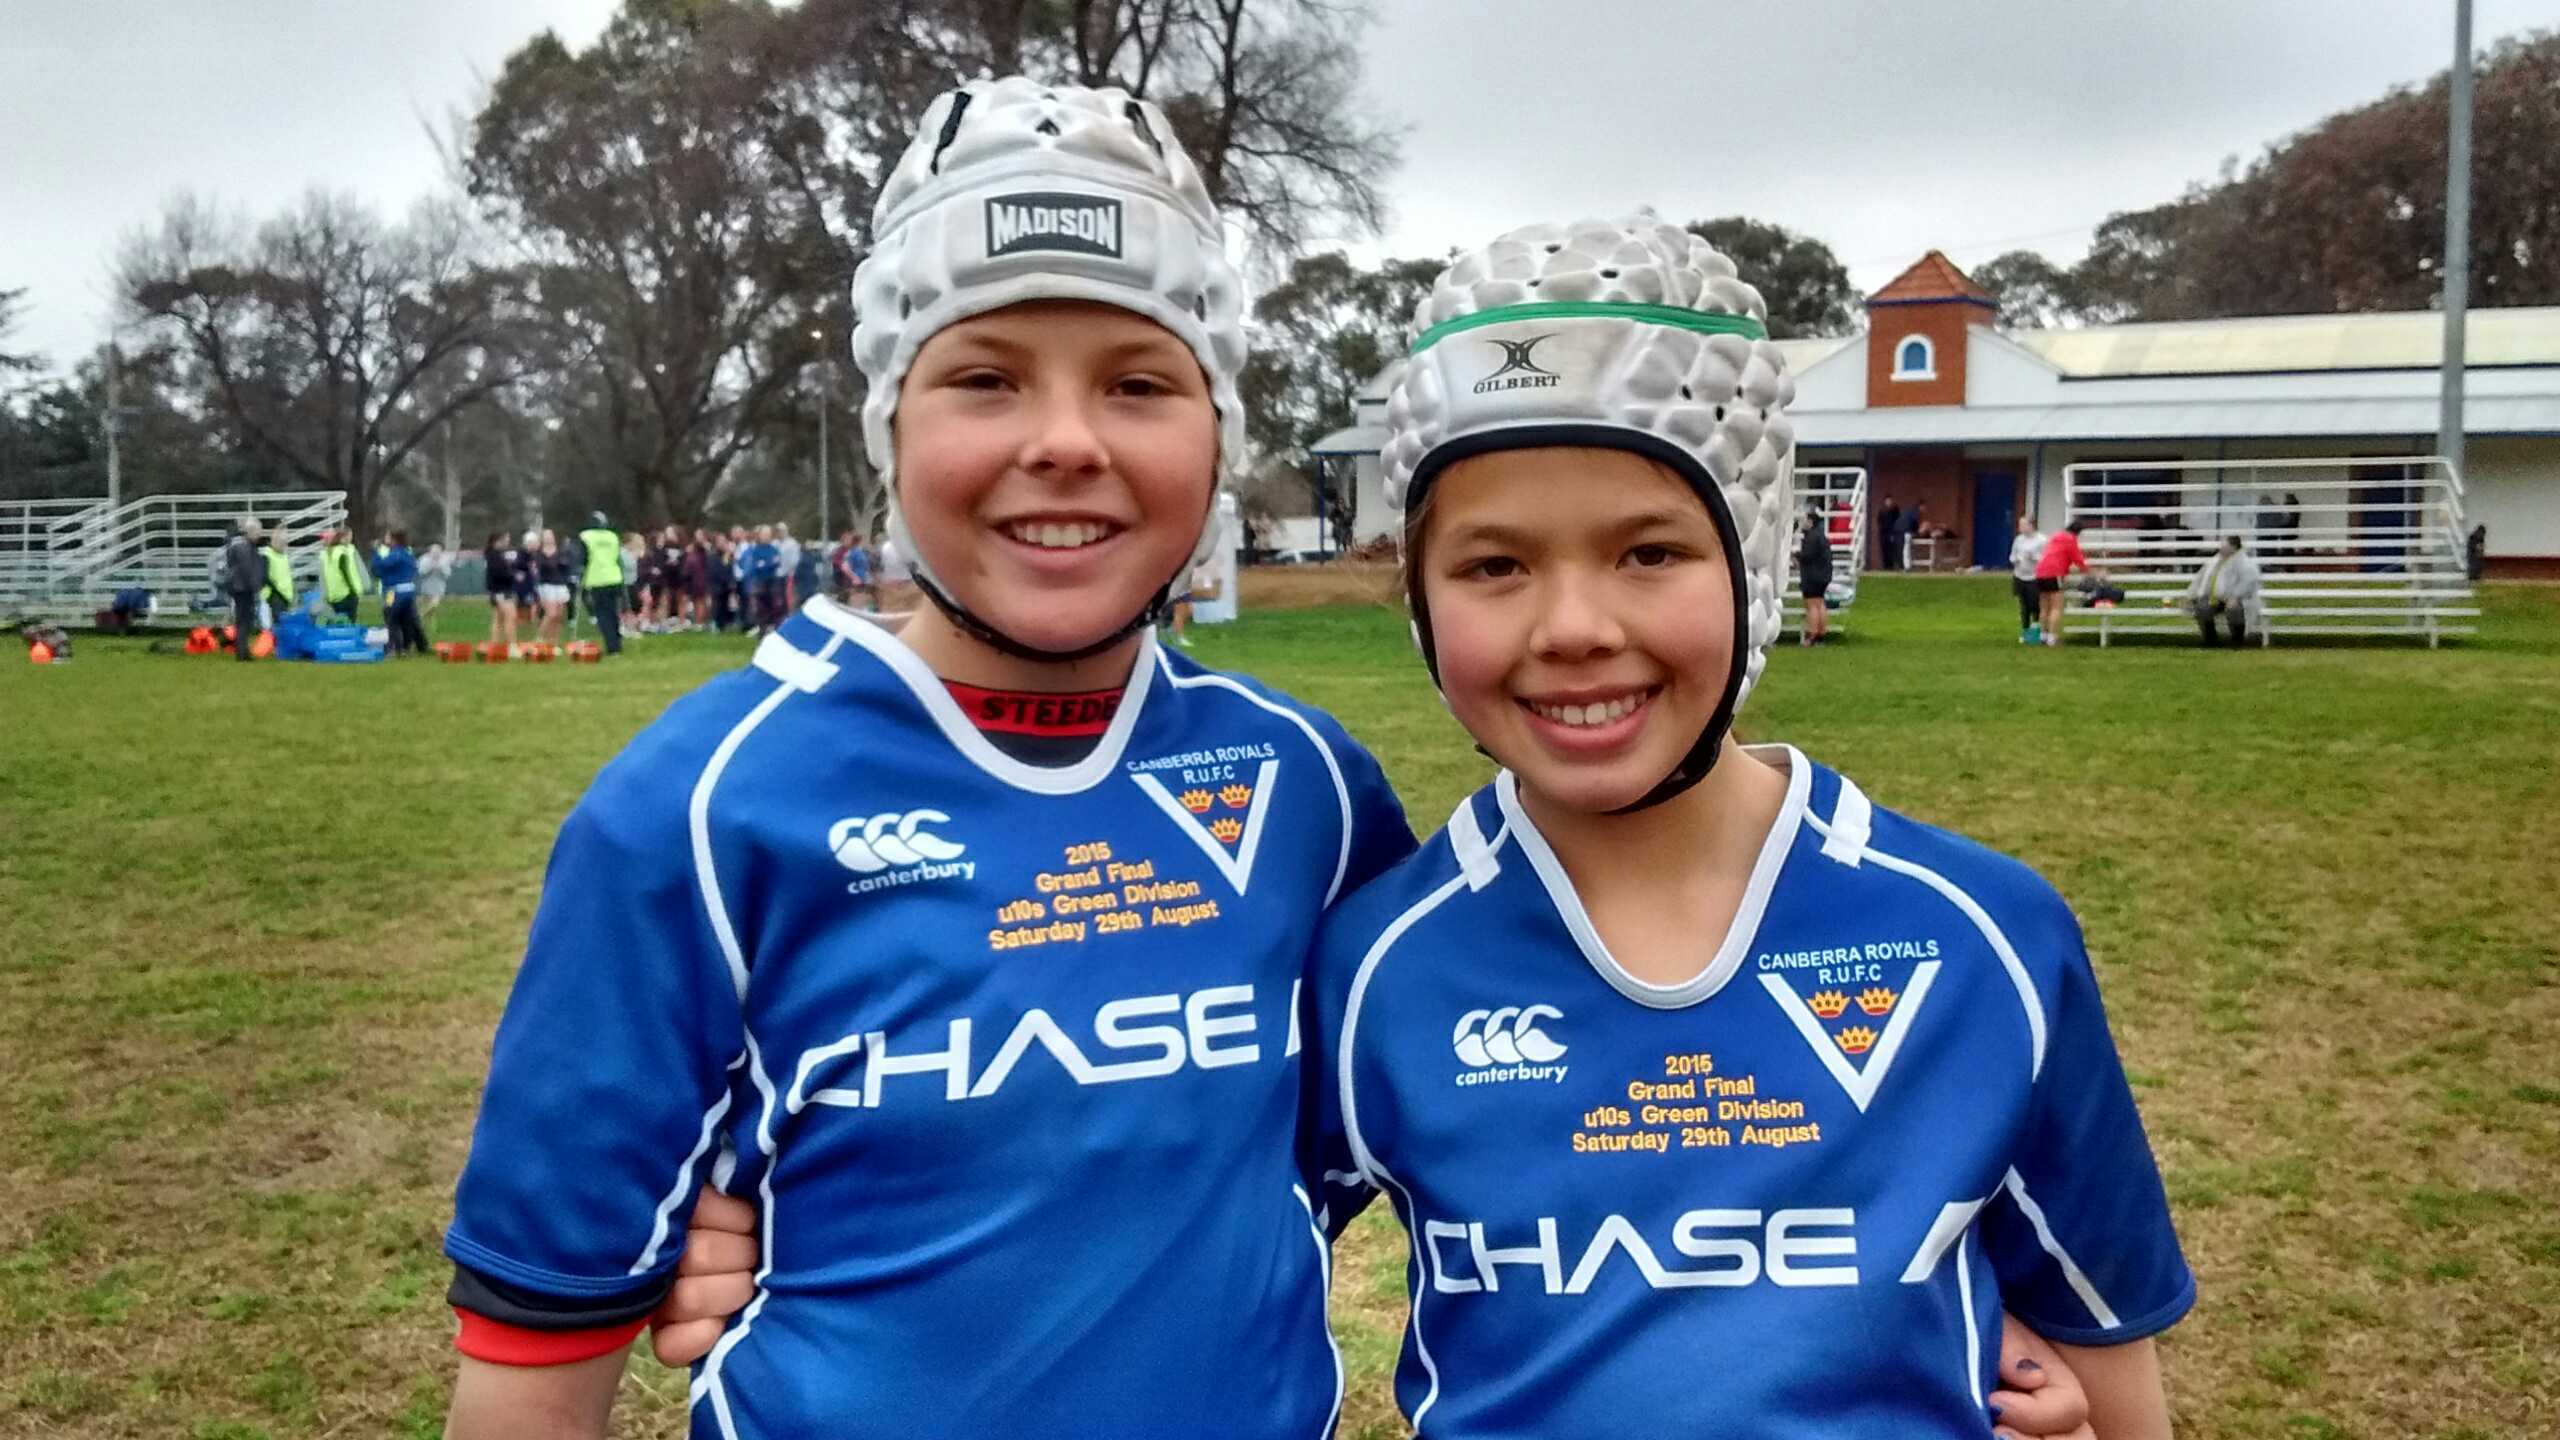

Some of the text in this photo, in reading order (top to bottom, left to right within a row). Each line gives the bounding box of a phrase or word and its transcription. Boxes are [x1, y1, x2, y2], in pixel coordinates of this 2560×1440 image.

[990, 201, 1117, 252] MADISON
[1473, 375, 1561, 394] GILBERT
[1126, 742, 1275, 772] CANBERRA ROYALS
[1065, 841, 1111, 866] 2015
[847, 861, 976, 894] canterbury
[1035, 859, 1154, 893] Grand Final
[997, 879, 1201, 923] u10s Green Division
[988, 899, 1221, 950] Saturday 29th August
[1758, 939, 1941, 970] CANBERRA ROYALS
[1818, 963, 1883, 985] R.U.F.C
[786, 984, 1260, 1115] CHASE
[1665, 1053, 1713, 1077] 2015
[1455, 1062, 1569, 1087] canterbury
[1627, 1075, 1755, 1101] Grand Final
[1583, 1099, 1805, 1128] u10s Green Division
[1572, 1122, 1821, 1153] Saturday 29th August
[1424, 1207, 1860, 1295] CHASE
